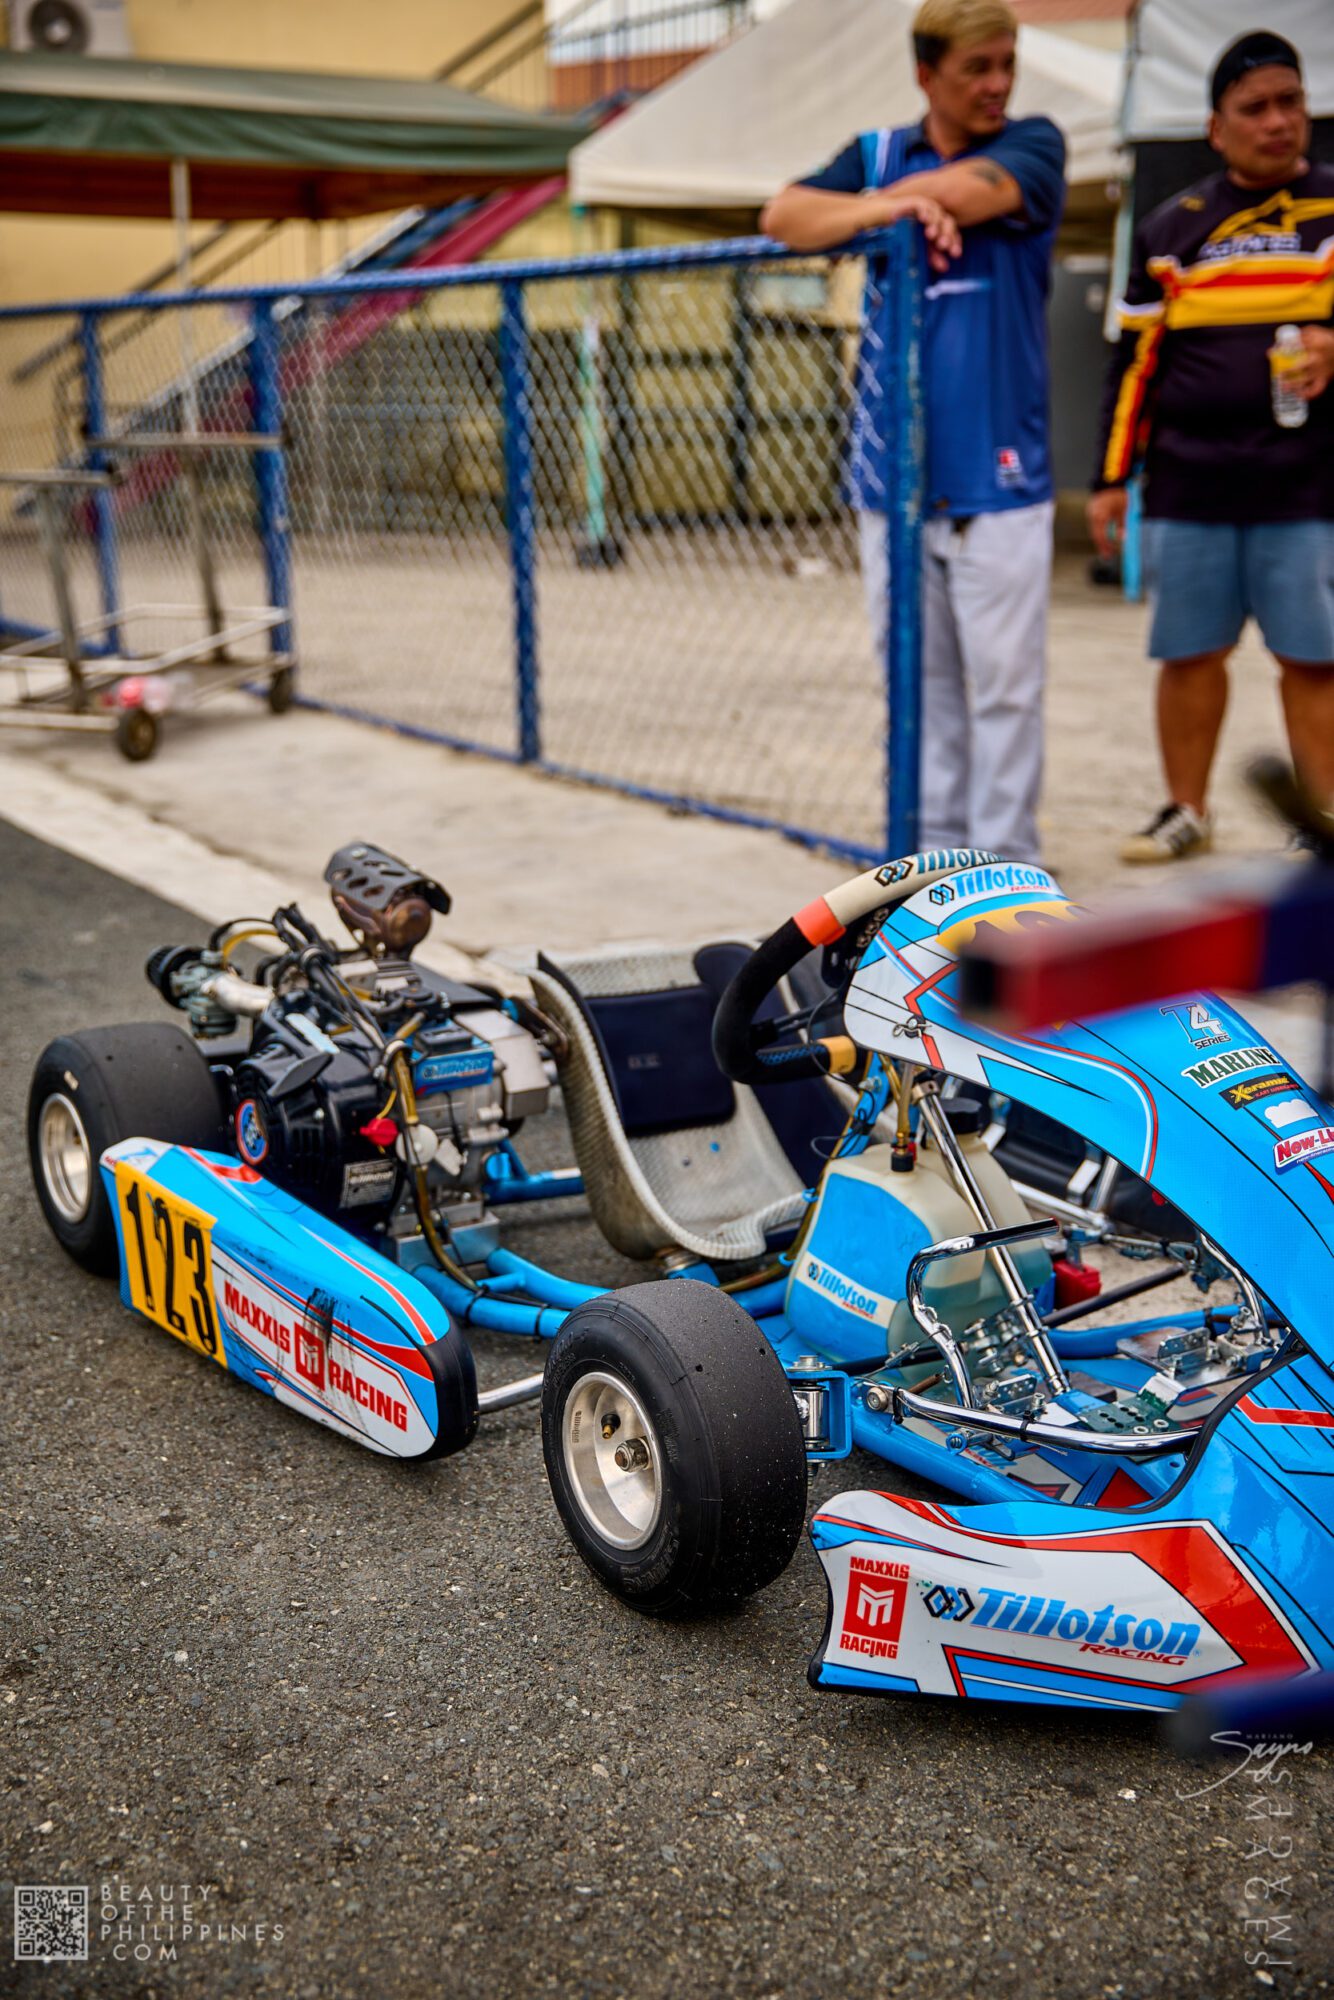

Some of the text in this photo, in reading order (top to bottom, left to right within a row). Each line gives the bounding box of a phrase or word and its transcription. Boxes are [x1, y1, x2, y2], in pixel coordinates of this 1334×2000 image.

[950, 864, 1050, 898] Tillotson
[1160, 1002, 1227, 1043] T4
[1194, 1034, 1232, 1050] SERIES
[1185, 1048, 1281, 1087] MARLINE
[125, 1181, 218, 1356] 123
[818, 1266, 878, 1315] Tillotson
[224, 1279, 291, 1355] MAXXIS
[328, 1359, 408, 1433] RACING
[850, 1556, 910, 1580] MAXXIS
[970, 1586, 1201, 1657] Tillotson
[839, 1633, 899, 1660] RACING
[1078, 1642, 1188, 1666] RACING
